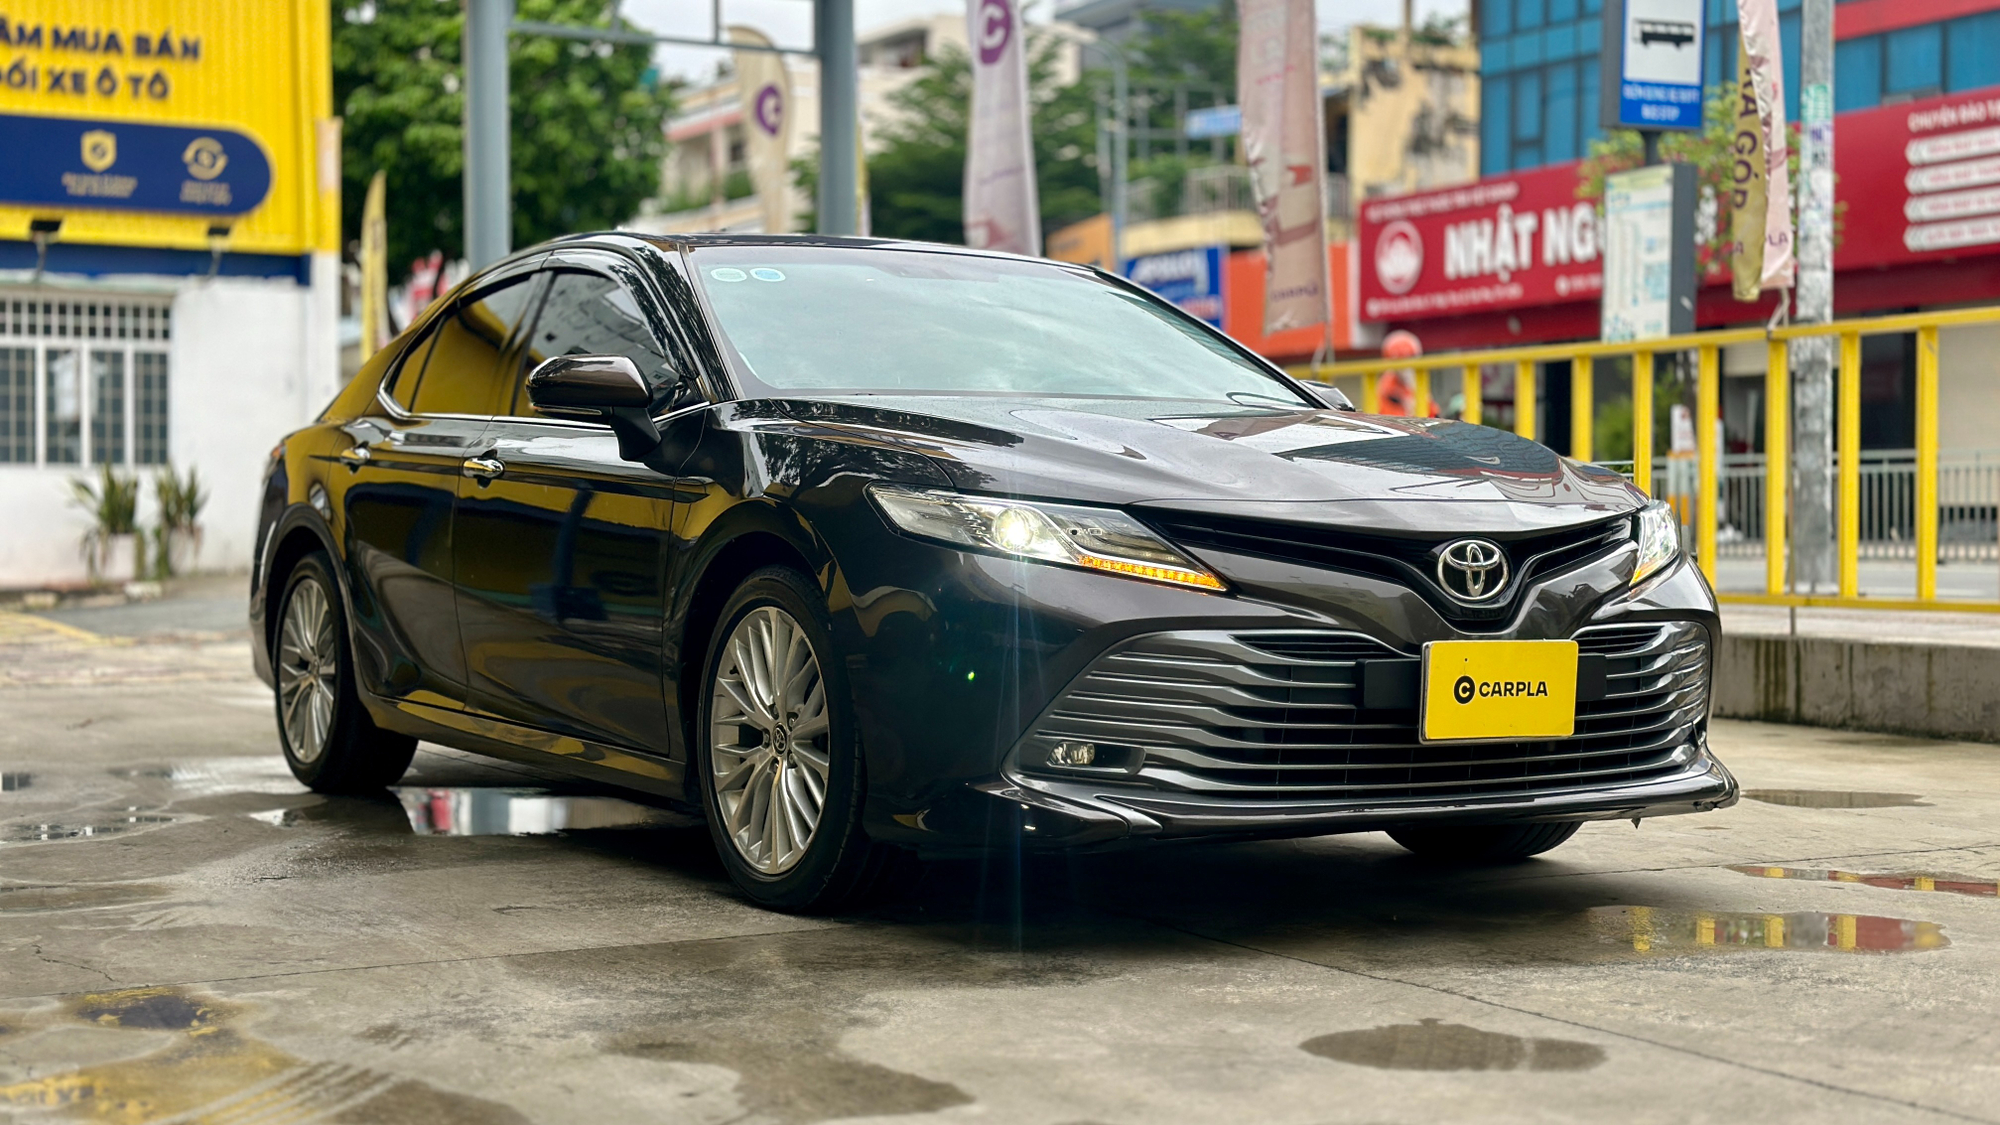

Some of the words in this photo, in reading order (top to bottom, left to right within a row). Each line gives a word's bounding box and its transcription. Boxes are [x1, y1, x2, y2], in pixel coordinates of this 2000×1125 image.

[52, 27, 122, 54] MUA
[134, 28, 200, 60] BÁN
[48, 69, 87, 95] XE
[96, 62, 117, 97] Ô
[128, 68, 169, 100] TÔ
[1733, 130, 1759, 210] GÓP
[1444, 202, 1539, 284] NHẬT
[1542, 201, 1605, 267] NG
[1478, 681, 1548, 697] CARPLA
